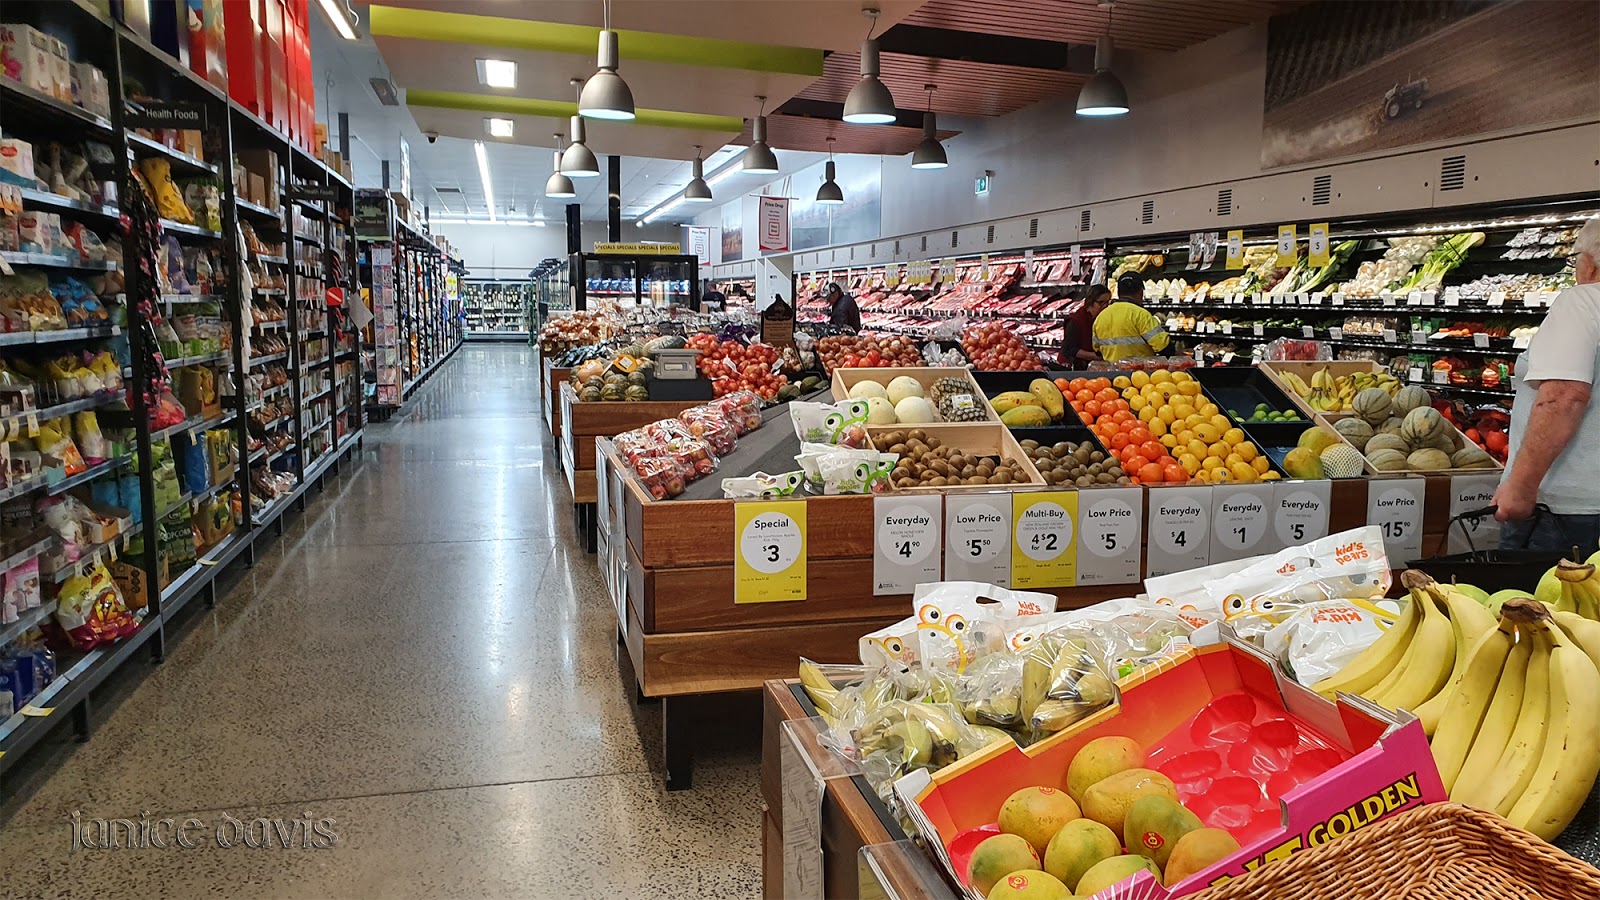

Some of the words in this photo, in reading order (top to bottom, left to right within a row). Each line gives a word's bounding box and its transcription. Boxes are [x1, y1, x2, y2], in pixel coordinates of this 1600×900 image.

[146, 109, 172, 119] Health
[174, 110, 199, 120] Foods
[1377, 499, 1393, 507] Low
[1395, 498, 1415, 506] Price
[1459, 494, 1476, 502] Low
[1477, 493, 1494, 501] Pric
[1222, 503, 1262, 514] Everyday
[1281, 499, 1320, 511] Everyday
[1025, 510, 1065, 519] Multi-Buy
[1088, 509, 1107, 518] Low
[1109, 508, 1131, 517] Price
[1160, 506, 1201, 517] Everyday
[754, 518, 789, 530] Special
[886, 515, 930, 527] Everyday
[956, 515, 976, 524] Low
[978, 514, 1001, 523] Price
[1233, 527, 1246, 544] $1
[1290, 524, 1305, 540] $5
[1041, 533, 1058, 551] $2
[1101, 533, 1116, 550] $5
[1171, 530, 1187, 547] $4
[762, 544, 780, 563] $3
[1335, 542, 1364, 557] kid's
[1335, 548, 1369, 566] pears
[1018, 601, 1041, 612] kid's
[1017, 609, 1042, 617] pea
[1307, 771, 1423, 848] GOLDEN
